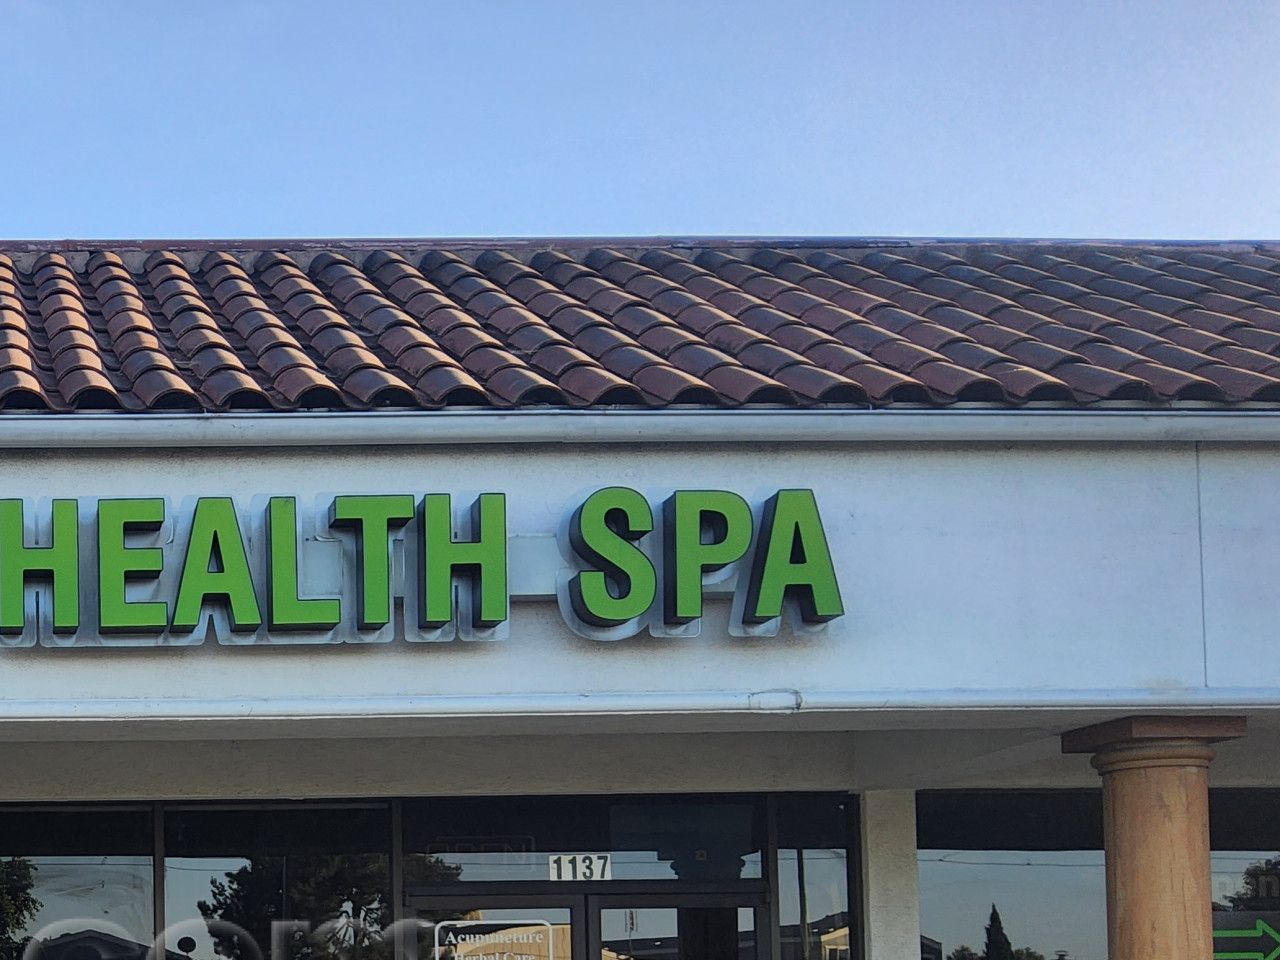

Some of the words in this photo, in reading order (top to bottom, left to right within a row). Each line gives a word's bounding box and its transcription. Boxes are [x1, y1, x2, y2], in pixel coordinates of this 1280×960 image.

[569, 486, 844, 629] SPA
[553, 855, 608, 880] 1137
[445, 931, 544, 946] Acupuncture
